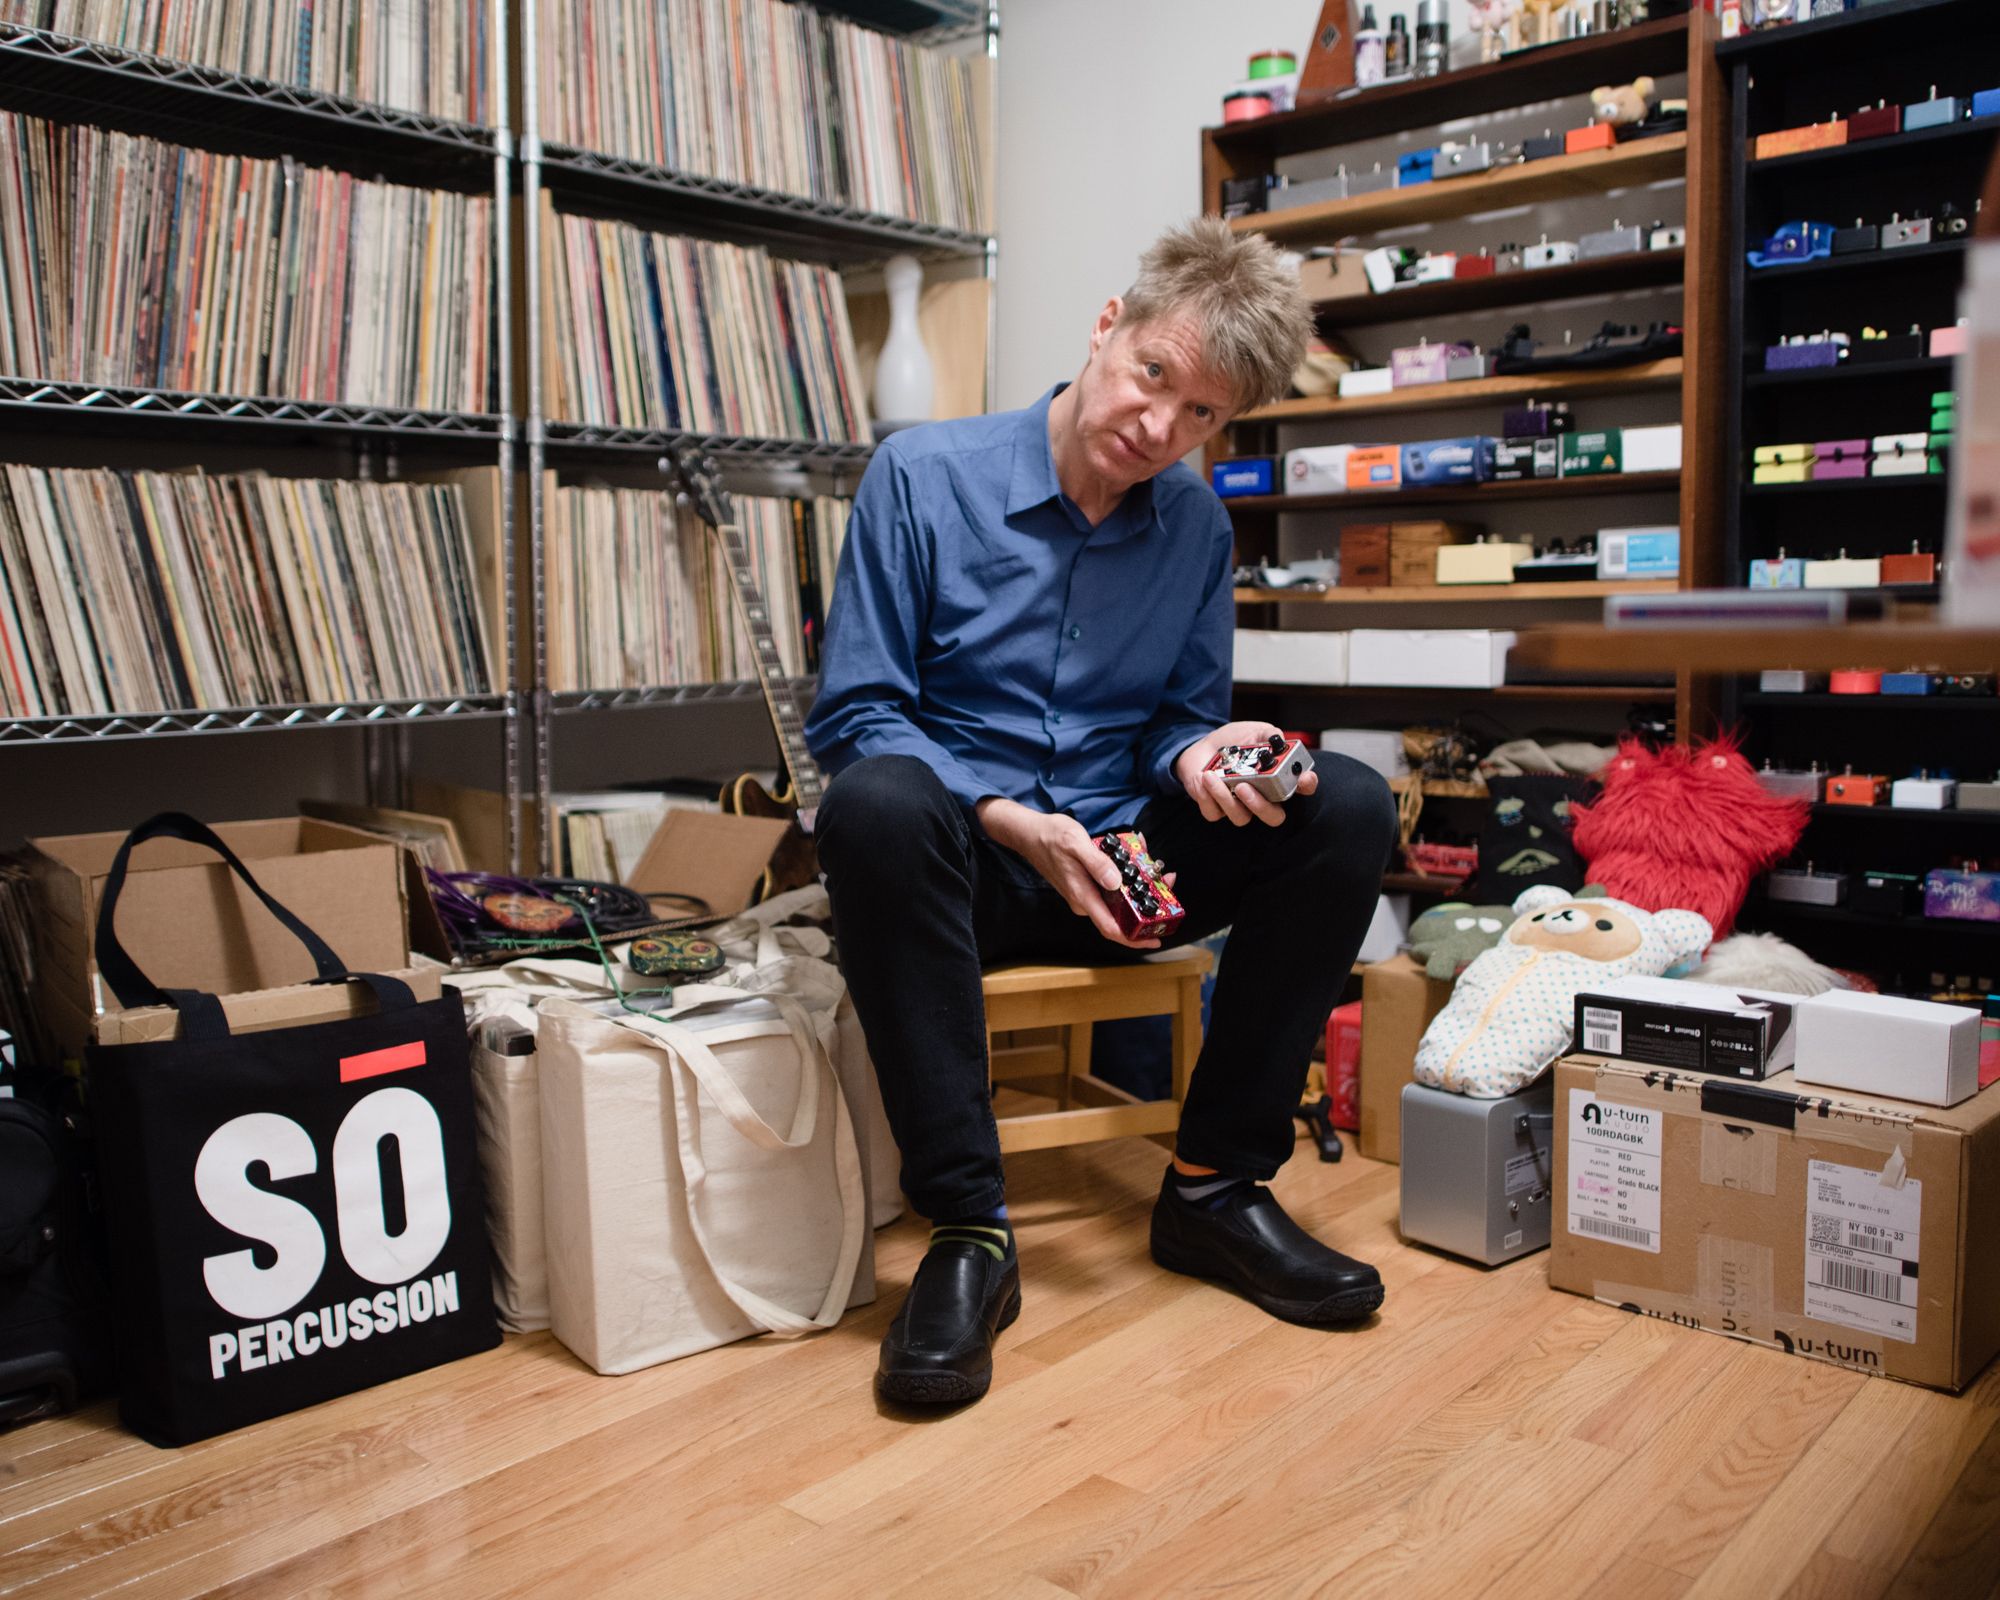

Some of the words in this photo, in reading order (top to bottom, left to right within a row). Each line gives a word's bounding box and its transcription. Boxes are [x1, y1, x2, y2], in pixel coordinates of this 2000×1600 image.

[1604, 1107, 1649, 1124] u-turn
[1604, 1120, 1650, 1134] AUDIO
[1586, 1127, 1644, 1144] 100RDAGBK
[1618, 1152, 1632, 1161] RED
[1618, 1165, 1646, 1177] ACRYLIC
[1618, 1177, 1637, 1188] Grado
[1638, 1182, 1660, 1193] BLACK
[1618, 1190, 1628, 1199] NO
[1618, 1202, 1628, 1211] NO
[1831, 1198, 1845, 1206] YORK
[1618, 1214, 1637, 1225] 15219
[1848, 1222, 1860, 1232] NY
[1863, 1225, 1878, 1236] 100
[1809, 1241, 1824, 1250] UPS
[1825, 1245, 1854, 1257] GROUND
[209, 1271, 460, 1380] PERCUSSION
[1798, 1337, 1878, 1366] u-turn
